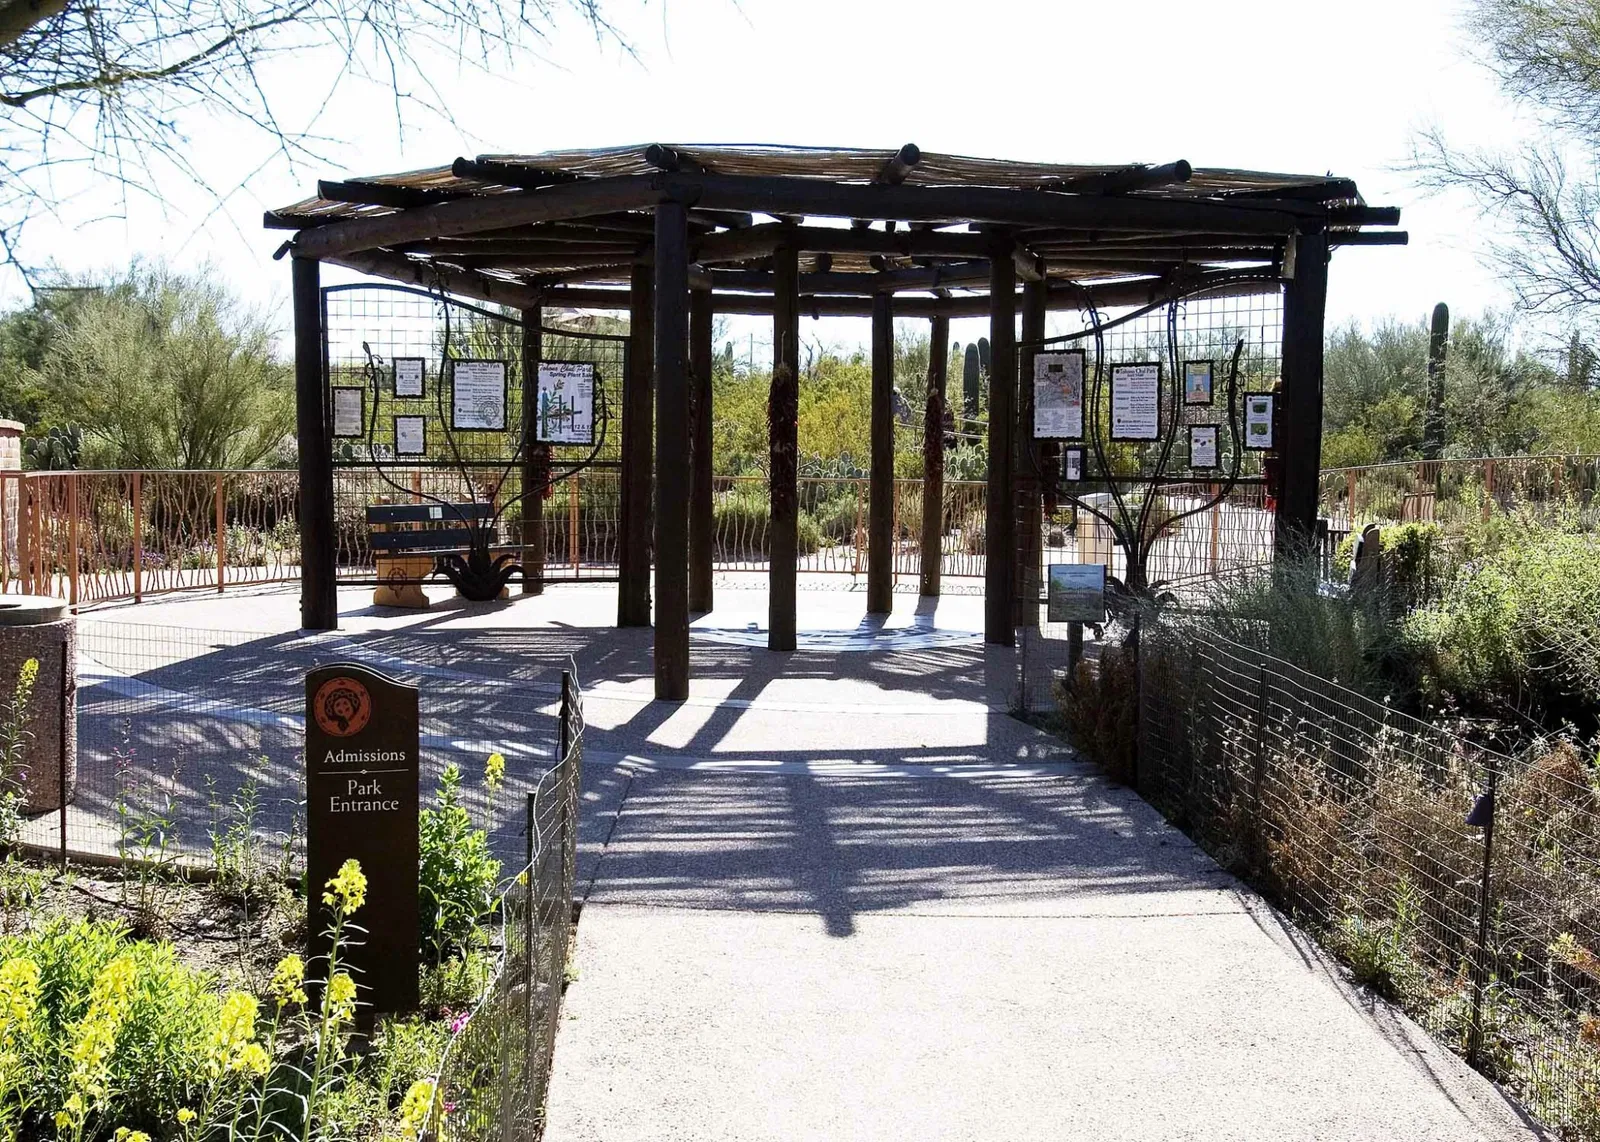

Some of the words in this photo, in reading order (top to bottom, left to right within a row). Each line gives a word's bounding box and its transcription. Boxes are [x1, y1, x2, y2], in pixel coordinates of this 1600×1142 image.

[324, 749, 406, 763] Admissions
[348, 779, 382, 796] Park
[330, 796, 399, 812] Entrance
